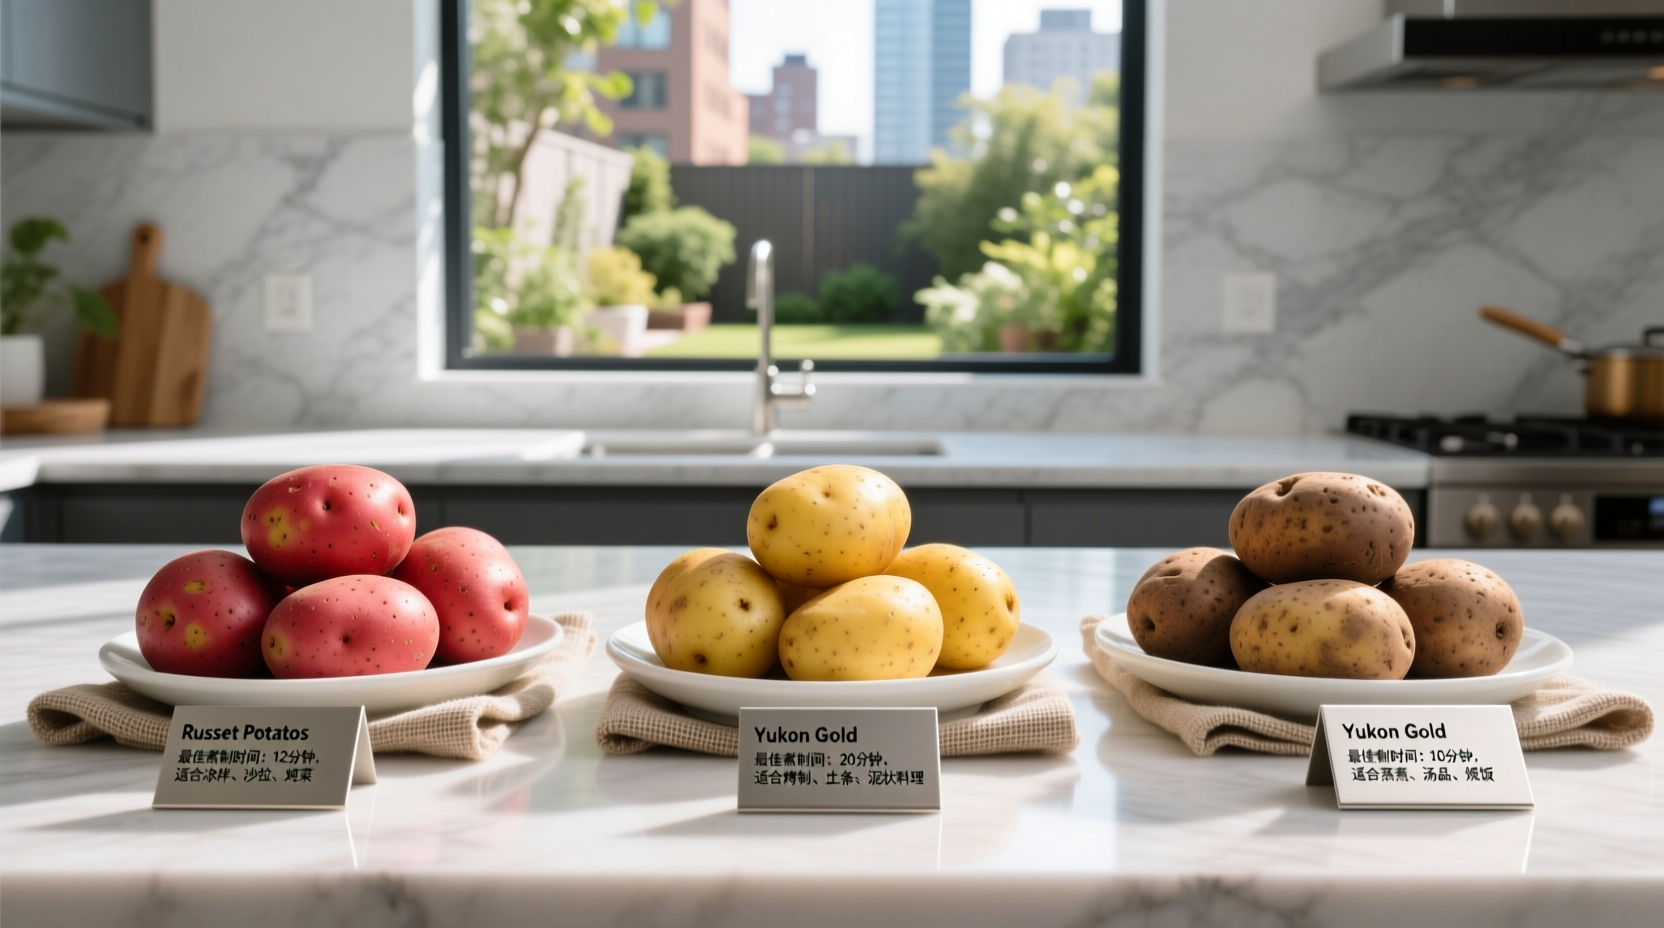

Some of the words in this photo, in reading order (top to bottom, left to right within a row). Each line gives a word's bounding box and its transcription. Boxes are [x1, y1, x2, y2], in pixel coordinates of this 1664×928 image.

[182, 724, 239, 740] Russet
[243, 724, 309, 740] Potatos
[754, 726, 810, 743] Yukon
[815, 726, 858, 743] Gold
[1342, 723, 1399, 739] Yukon
[1404, 722, 1447, 738] Gold
